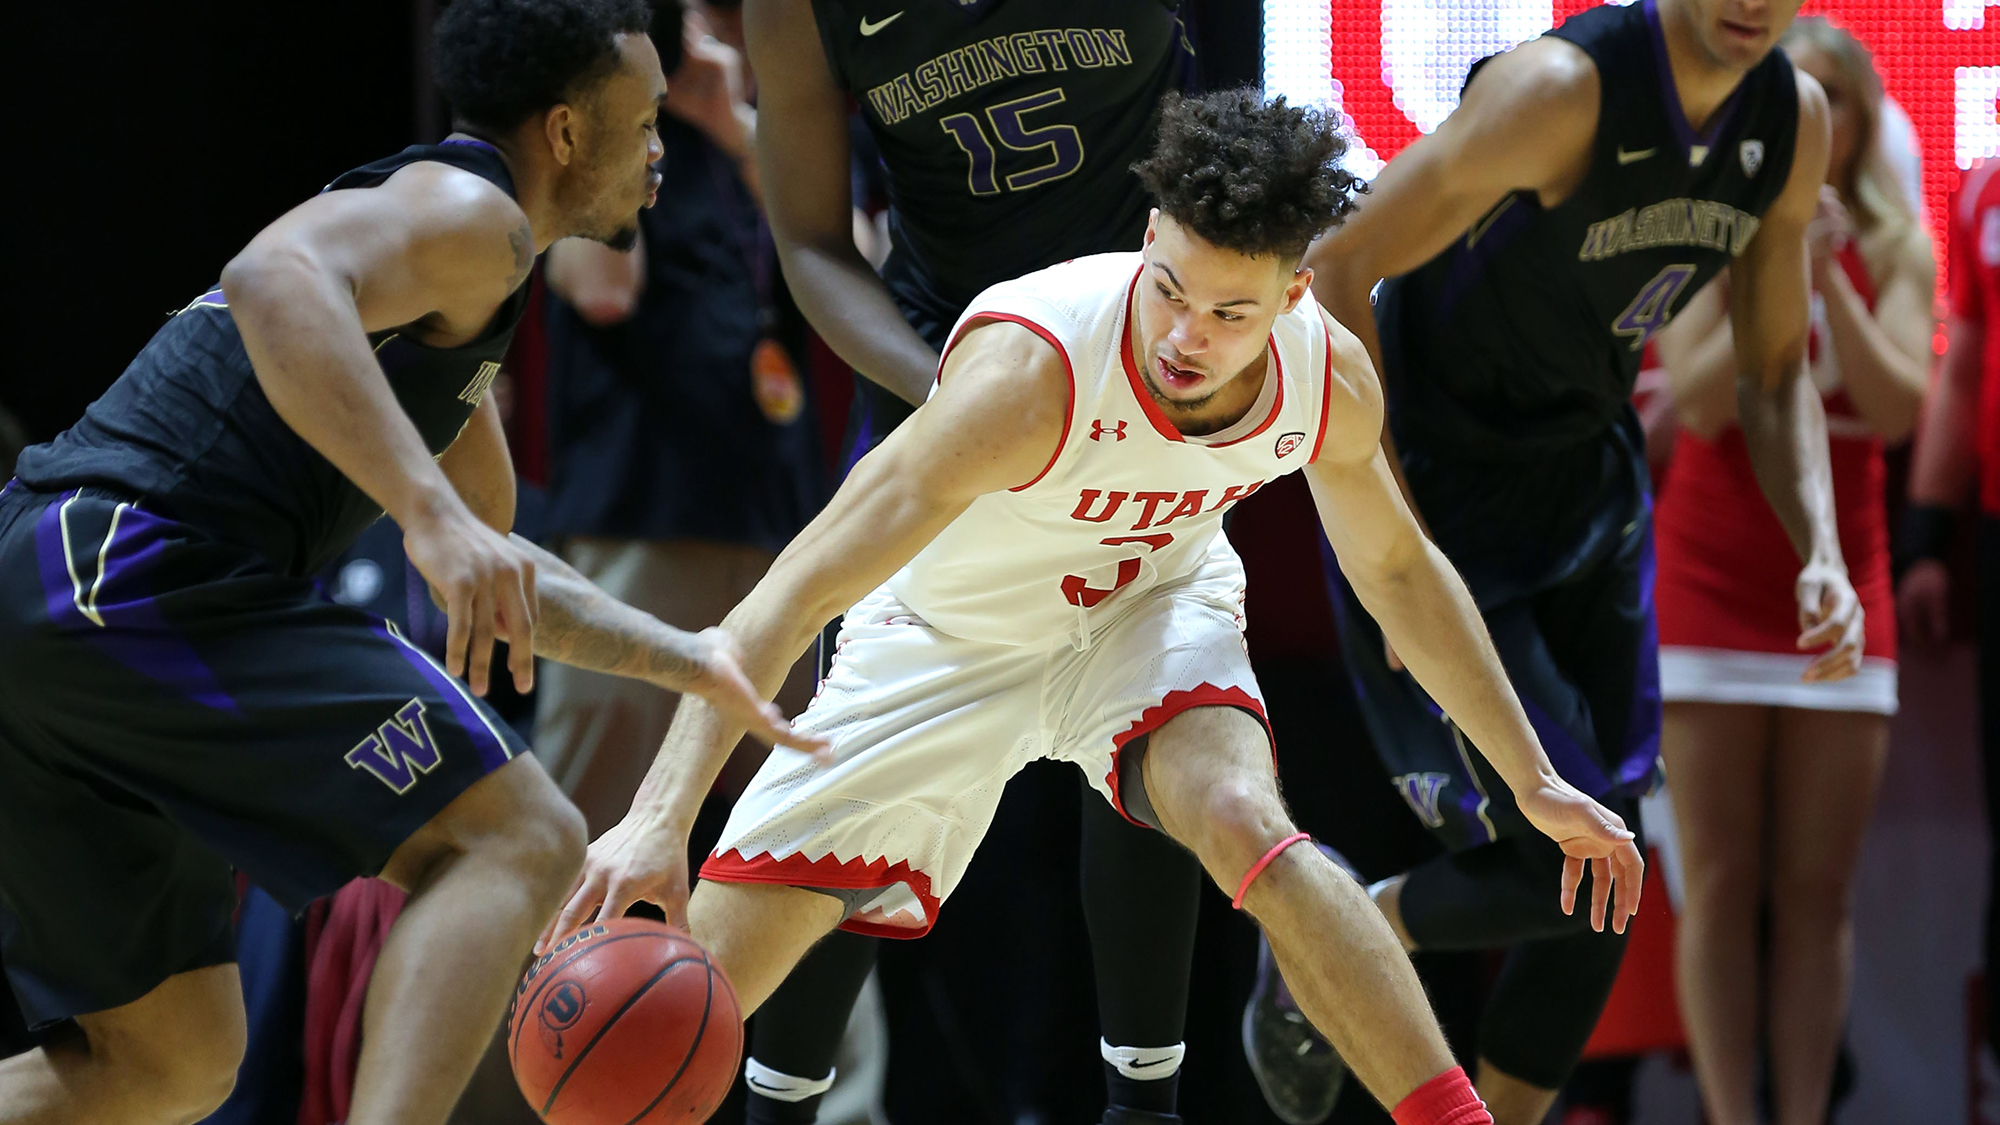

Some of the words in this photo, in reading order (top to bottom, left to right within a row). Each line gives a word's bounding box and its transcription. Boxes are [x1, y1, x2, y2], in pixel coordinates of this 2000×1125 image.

[868, 28, 1132, 125] WASHINGTON
[940, 87, 1084, 195] 15
[1611, 263, 1697, 351] 4
[1069, 479, 1266, 531] UTAH
[343, 696, 442, 795] W
